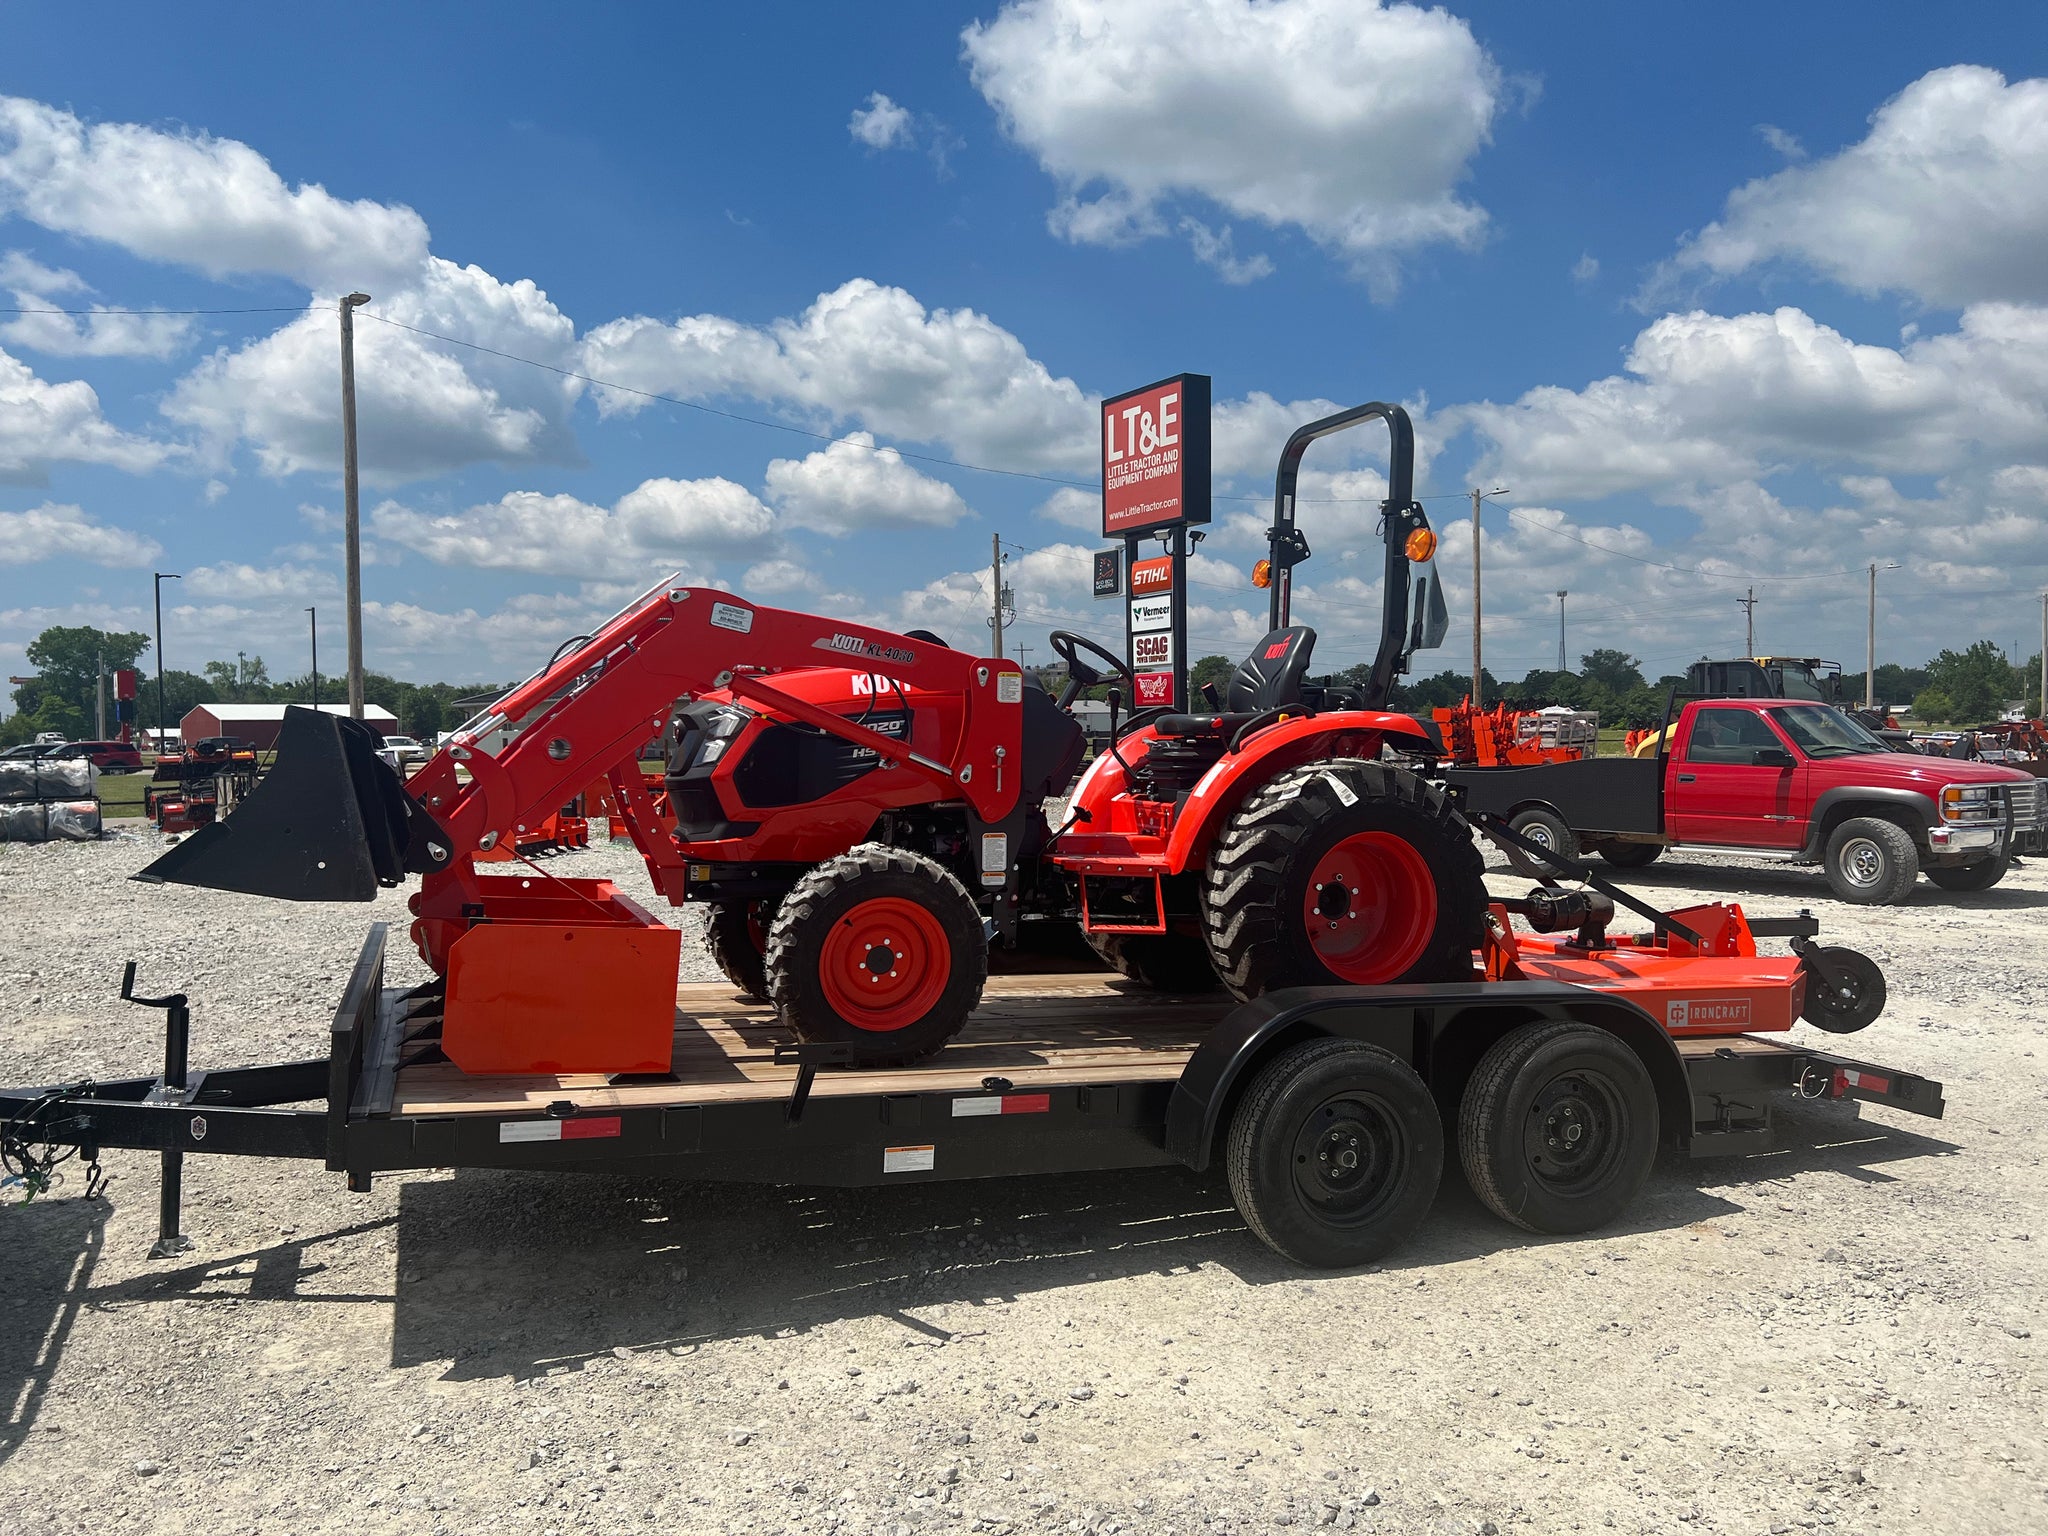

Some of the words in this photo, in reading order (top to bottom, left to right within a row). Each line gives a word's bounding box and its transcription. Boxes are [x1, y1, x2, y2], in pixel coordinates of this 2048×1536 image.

[1107, 392, 1178, 463] LT&E
[1107, 462, 1129, 478] LITTLE
[1130, 453, 1161, 471] TRACTOR
[1162, 448, 1178, 464] AND
[1108, 470, 1143, 490] EQUIPMENT
[1144, 462, 1178, 481] COMPANY
[1109, 497, 1178, 521] www.LittleTractor.com
[1133, 565, 1168, 586] STIHL
[1143, 606, 1170, 616] Vermeer
[830, 633, 865, 653] KIOTI
[867, 643, 881, 657] KL
[1136, 636, 1168, 656] SCAG
[862, 720, 902, 732] 020
